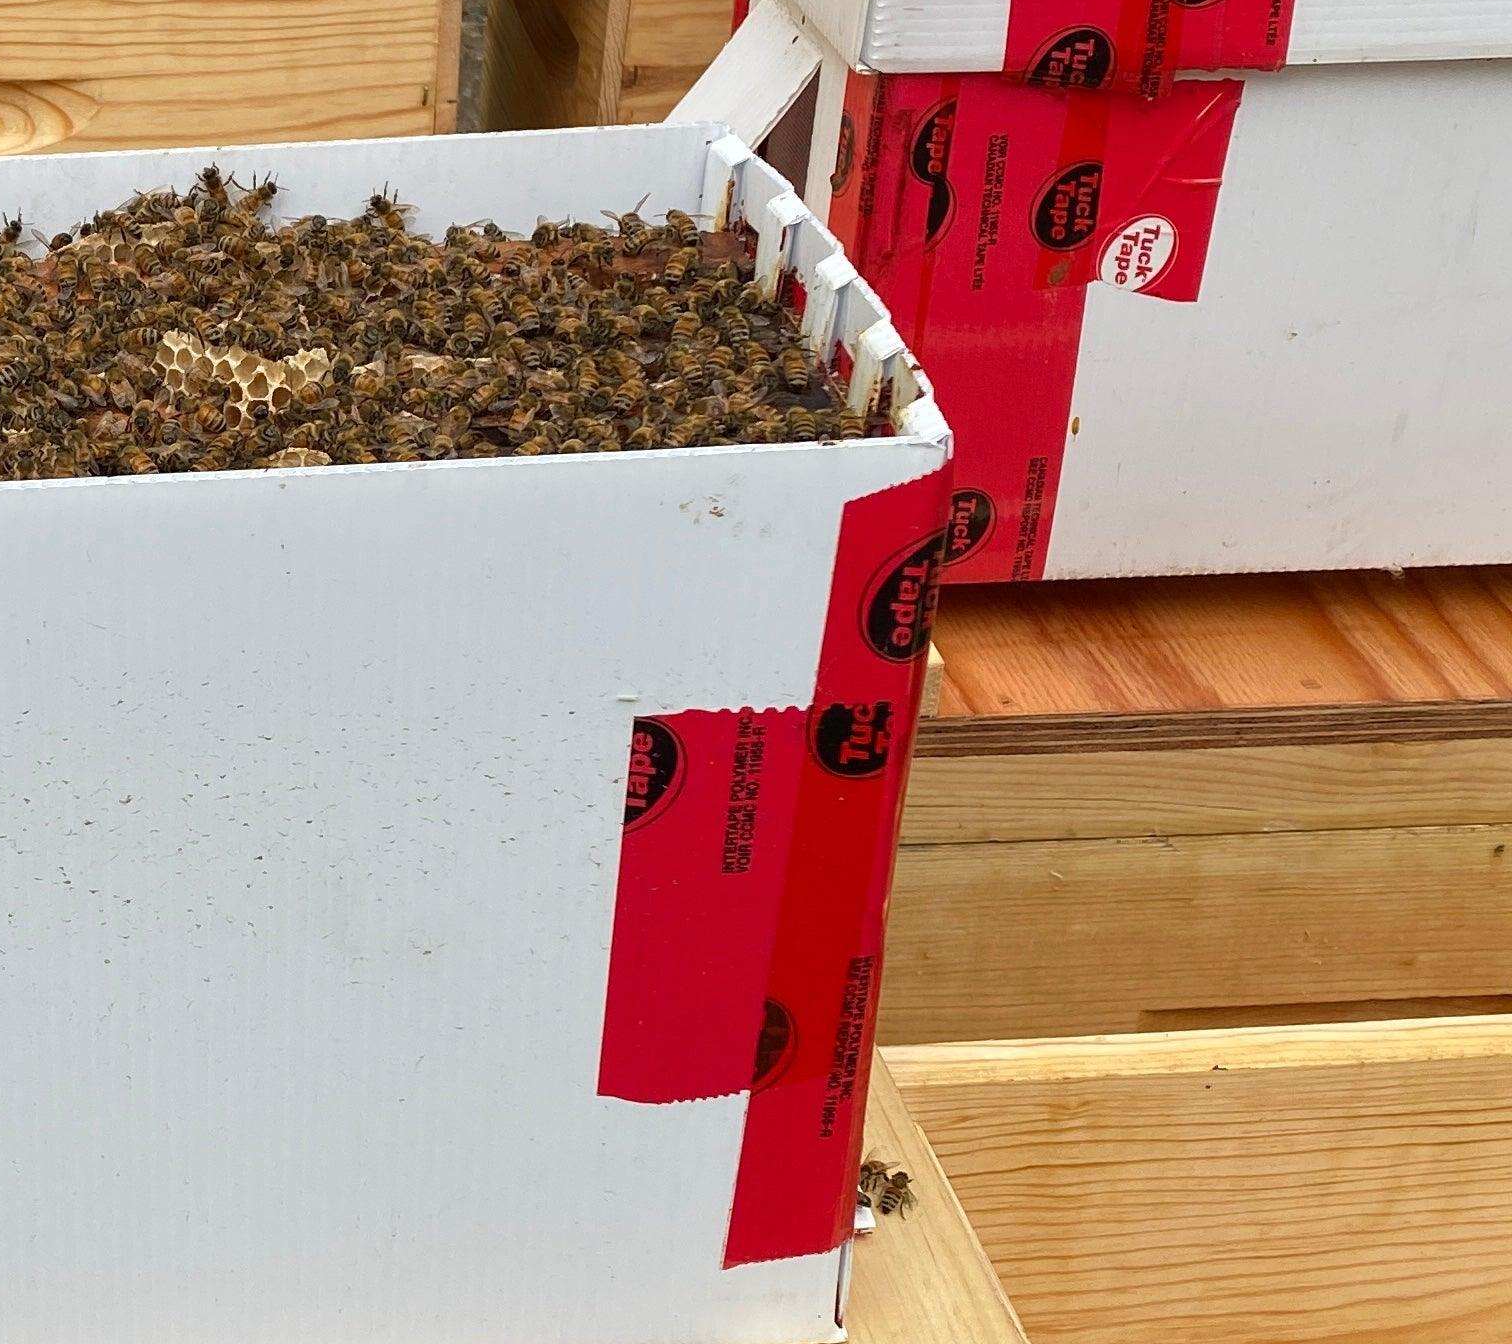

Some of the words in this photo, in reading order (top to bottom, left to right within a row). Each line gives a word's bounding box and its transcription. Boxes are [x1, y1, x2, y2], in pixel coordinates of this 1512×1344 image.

[926, 114, 953, 176] Tape
[1048, 180, 1076, 240] Tape
[1071, 172, 1099, 234] Tuck
[1113, 231, 1140, 285] Tape
[1133, 224, 1162, 282] Tuck
[951, 497, 977, 551] Tuck
[890, 560, 929, 647] Tape
[840, 705, 876, 764] Tuc
[730, 743, 749, 804] POLYMER
[745, 780, 760, 800] NO.
[722, 807, 742, 874] INTERTAPE
[740, 804, 757, 841] CCMC
[737, 844, 753, 874] VOIR
[841, 983, 857, 1019] CCMC
[843, 1022, 864, 1078] POLYMER
